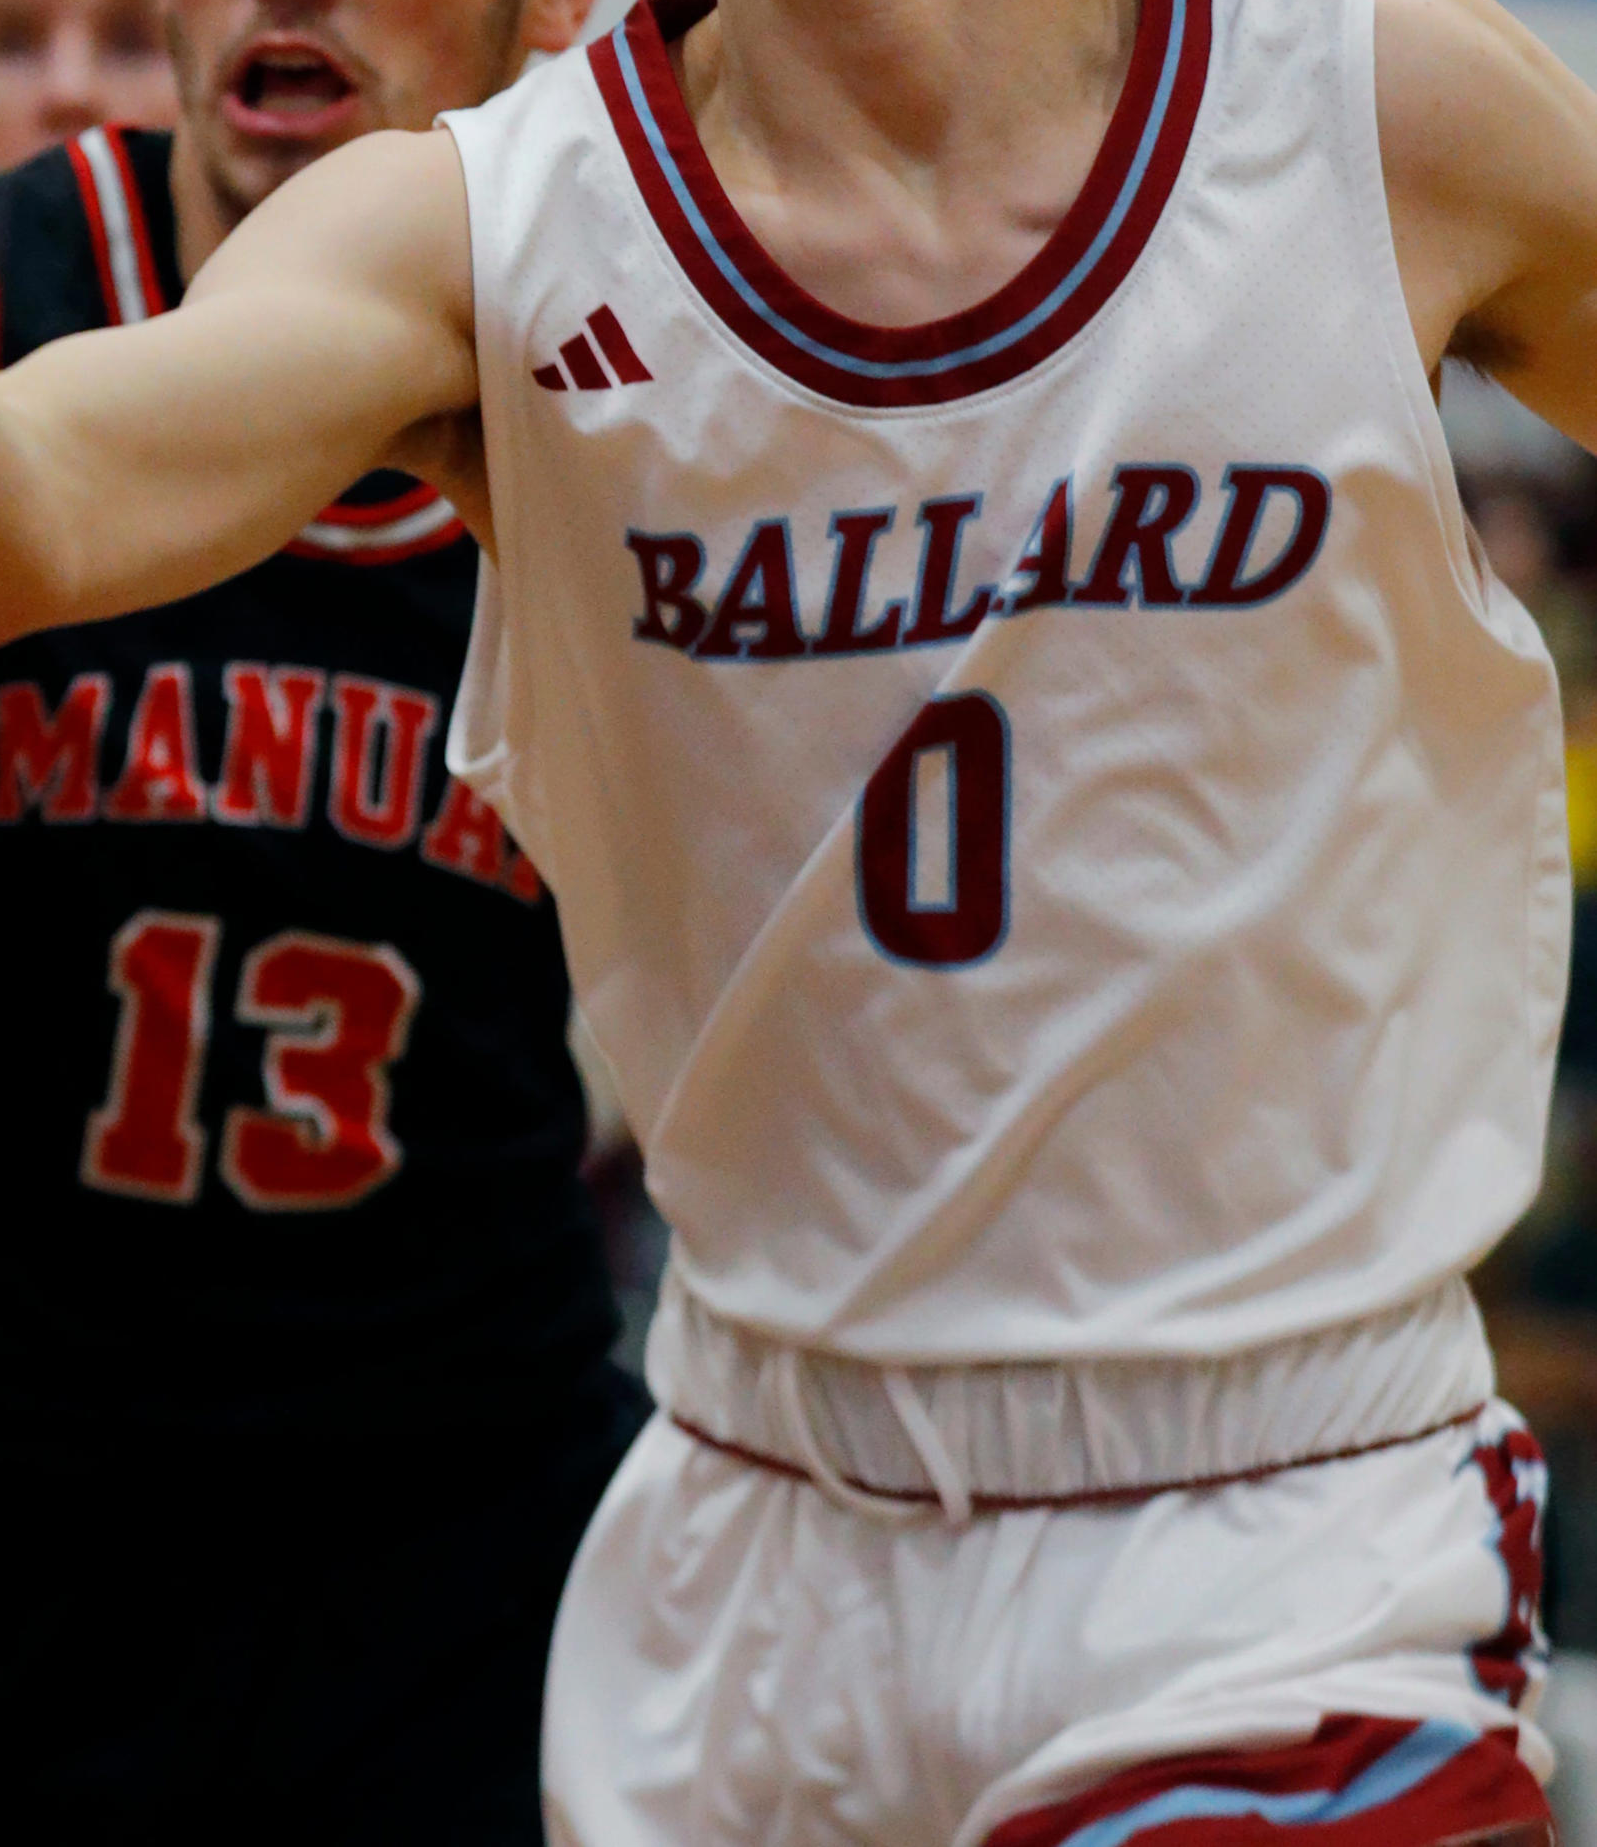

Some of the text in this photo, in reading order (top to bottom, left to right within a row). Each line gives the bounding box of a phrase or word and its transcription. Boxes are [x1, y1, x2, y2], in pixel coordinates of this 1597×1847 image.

[625, 462, 1333, 663] BALLARD
[854, 687, 1012, 971] 0
[80, 909, 421, 1212] 13
